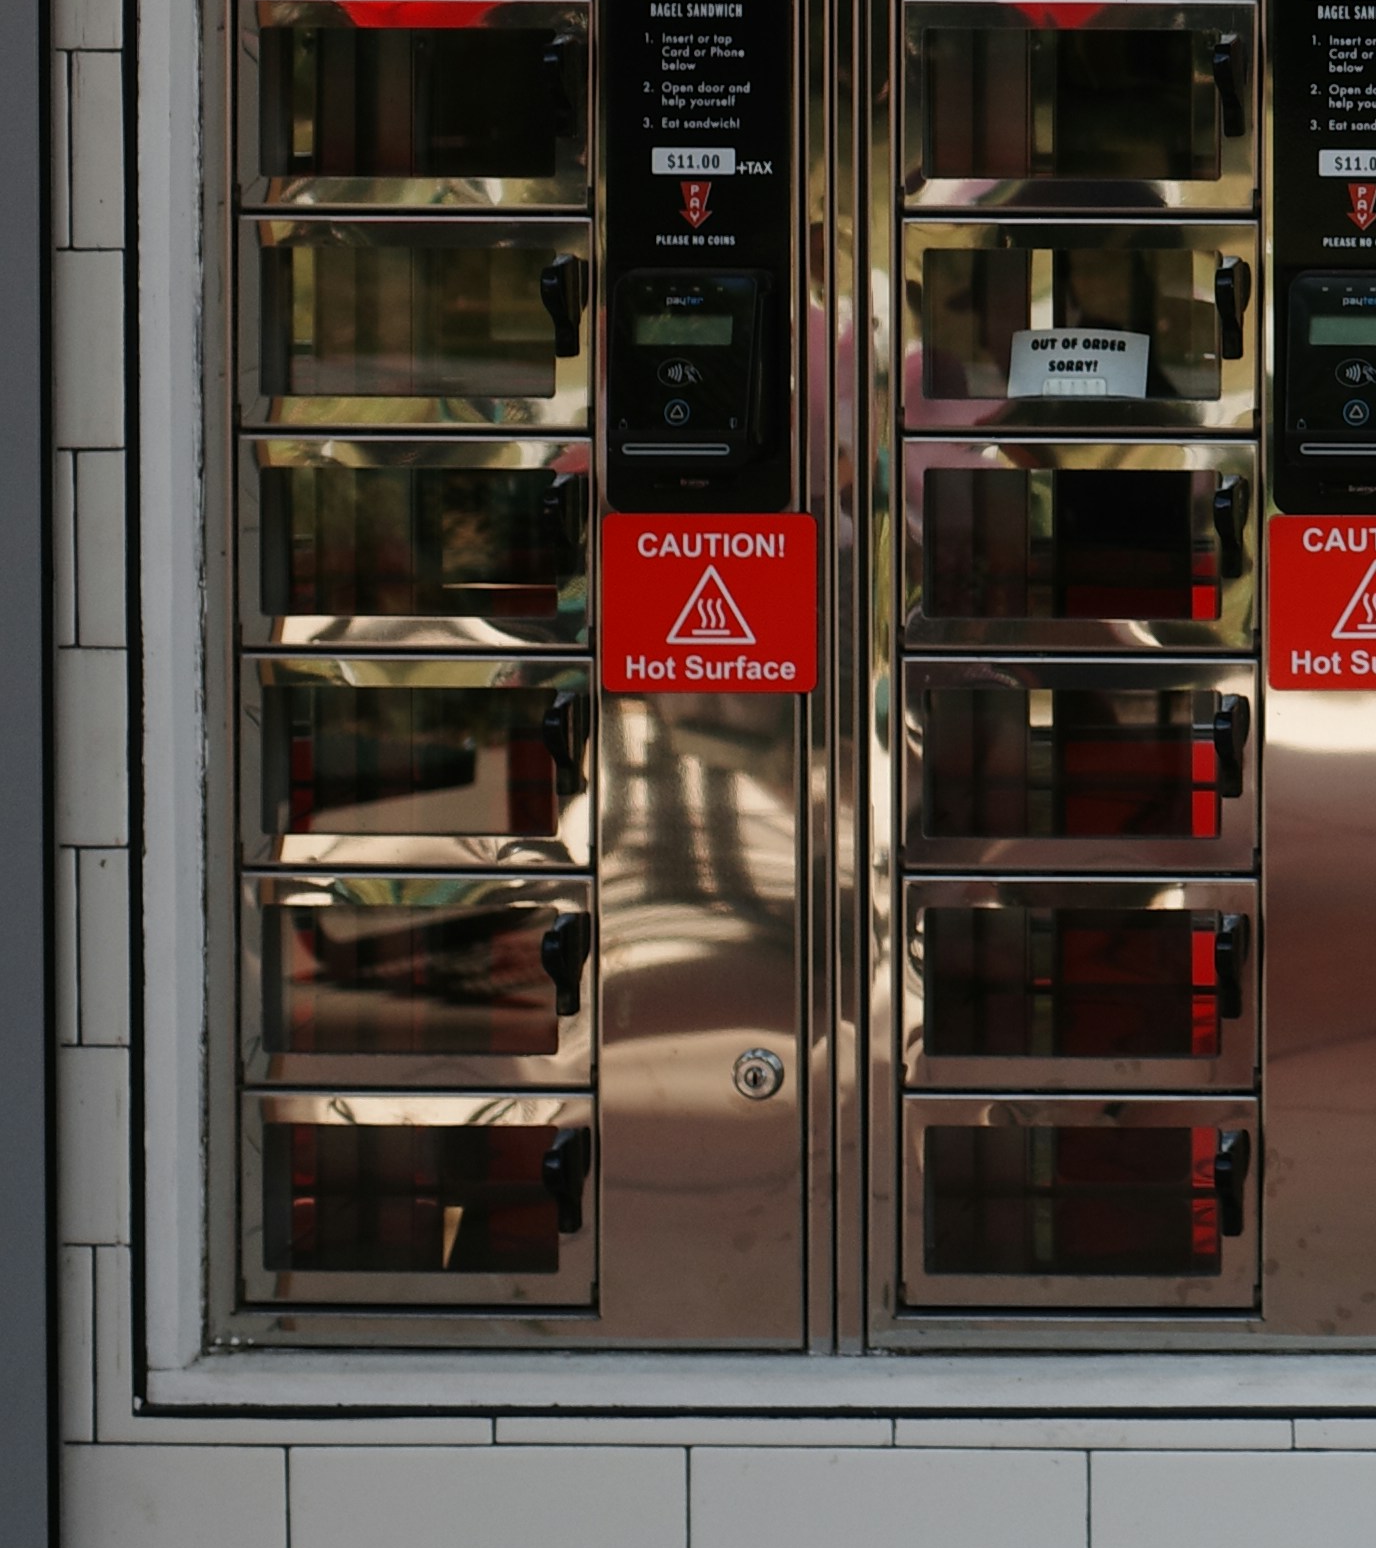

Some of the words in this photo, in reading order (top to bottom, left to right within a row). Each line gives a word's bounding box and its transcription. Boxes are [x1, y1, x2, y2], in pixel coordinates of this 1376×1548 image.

[650, 2, 683, 17] BAGEL
[686, 3, 743, 18] SANDWICH
[1317, 5, 1350, 20] BAGEL
[667, 153, 720, 170] $11.00
[736, 161, 773, 175] +TAX
[655, 235, 689, 245] PLEASE
[692, 235, 705, 245] NO
[707, 235, 736, 245] COINS
[1322, 237, 1356, 247] PLEASE
[1359, 237, 1373, 247] NO
[1031, 338, 1058, 351] OUT
[1061, 337, 1078, 350] OF
[1082, 338, 1127, 352] ORDER
[1048, 359, 1099, 372] SORRY!
[637, 532, 785, 558] CAUTION!
[626, 655, 676, 680] Hot
[685, 655, 796, 680] Surface
[1291, 650, 1342, 675] Hot
